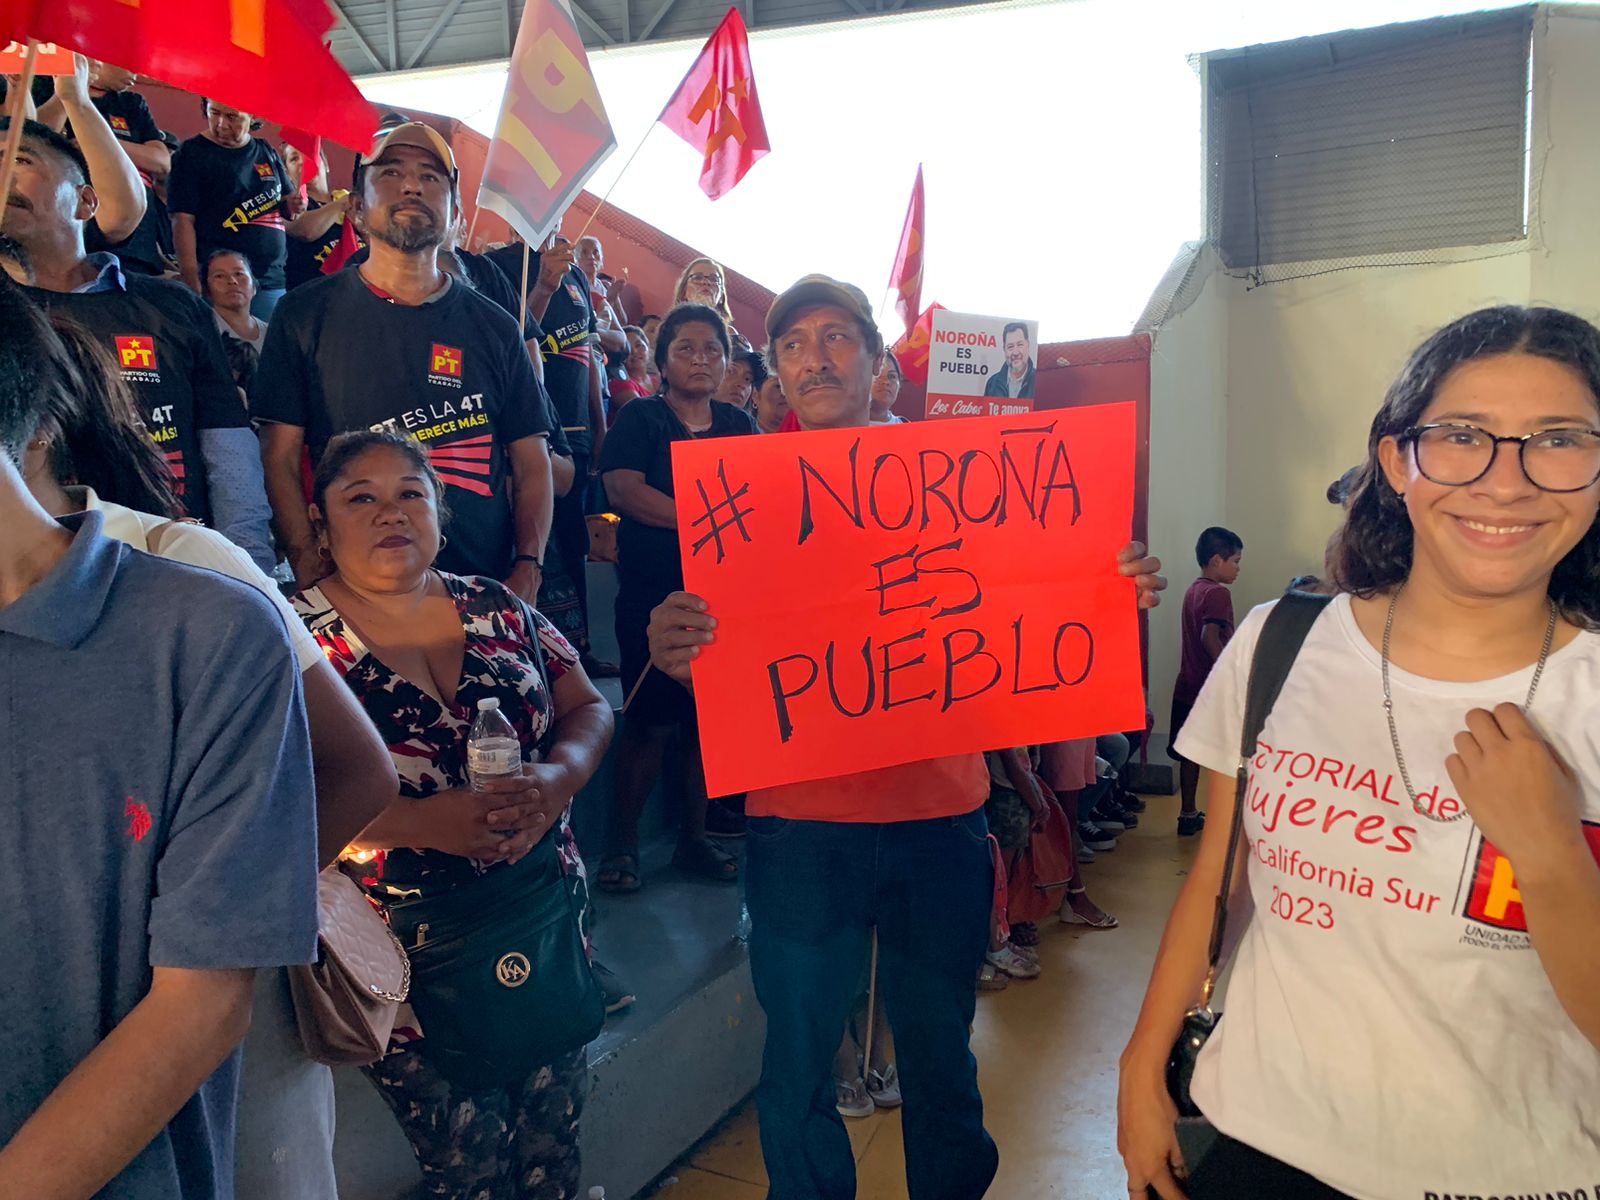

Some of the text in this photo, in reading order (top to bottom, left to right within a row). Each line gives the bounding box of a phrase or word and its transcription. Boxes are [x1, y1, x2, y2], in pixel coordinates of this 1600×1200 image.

[241, 199, 255, 210] PT
[556, 327, 567, 338] PT
[567, 322, 579, 334] ES
[935, 330, 997, 347] NOROÑA
[121, 349, 151, 366] PT
[956, 348, 972, 359] ES
[433, 355, 459, 373] PT
[940, 362, 989, 375] PUEBLO
[152, 405, 173, 424] 4T
[401, 407, 428, 429] ES
[429, 400, 457, 419] LA
[461, 394, 483, 411] 4T
[929, 399, 949, 415] Los
[951, 400, 983, 416] Cabos
[989, 402, 999, 416] Te
[457, 413, 489, 430] MÁS!
[148, 426, 178, 442] MÁS!
[691, 420, 1082, 564] # NOROÑA
[866, 538, 982, 620] ES
[767, 614, 1094, 744] PUEBLO
[1413, 785, 1460, 819] de
[1257, 839, 1440, 913] California Sur
[1270, 885, 1334, 929] 2023
